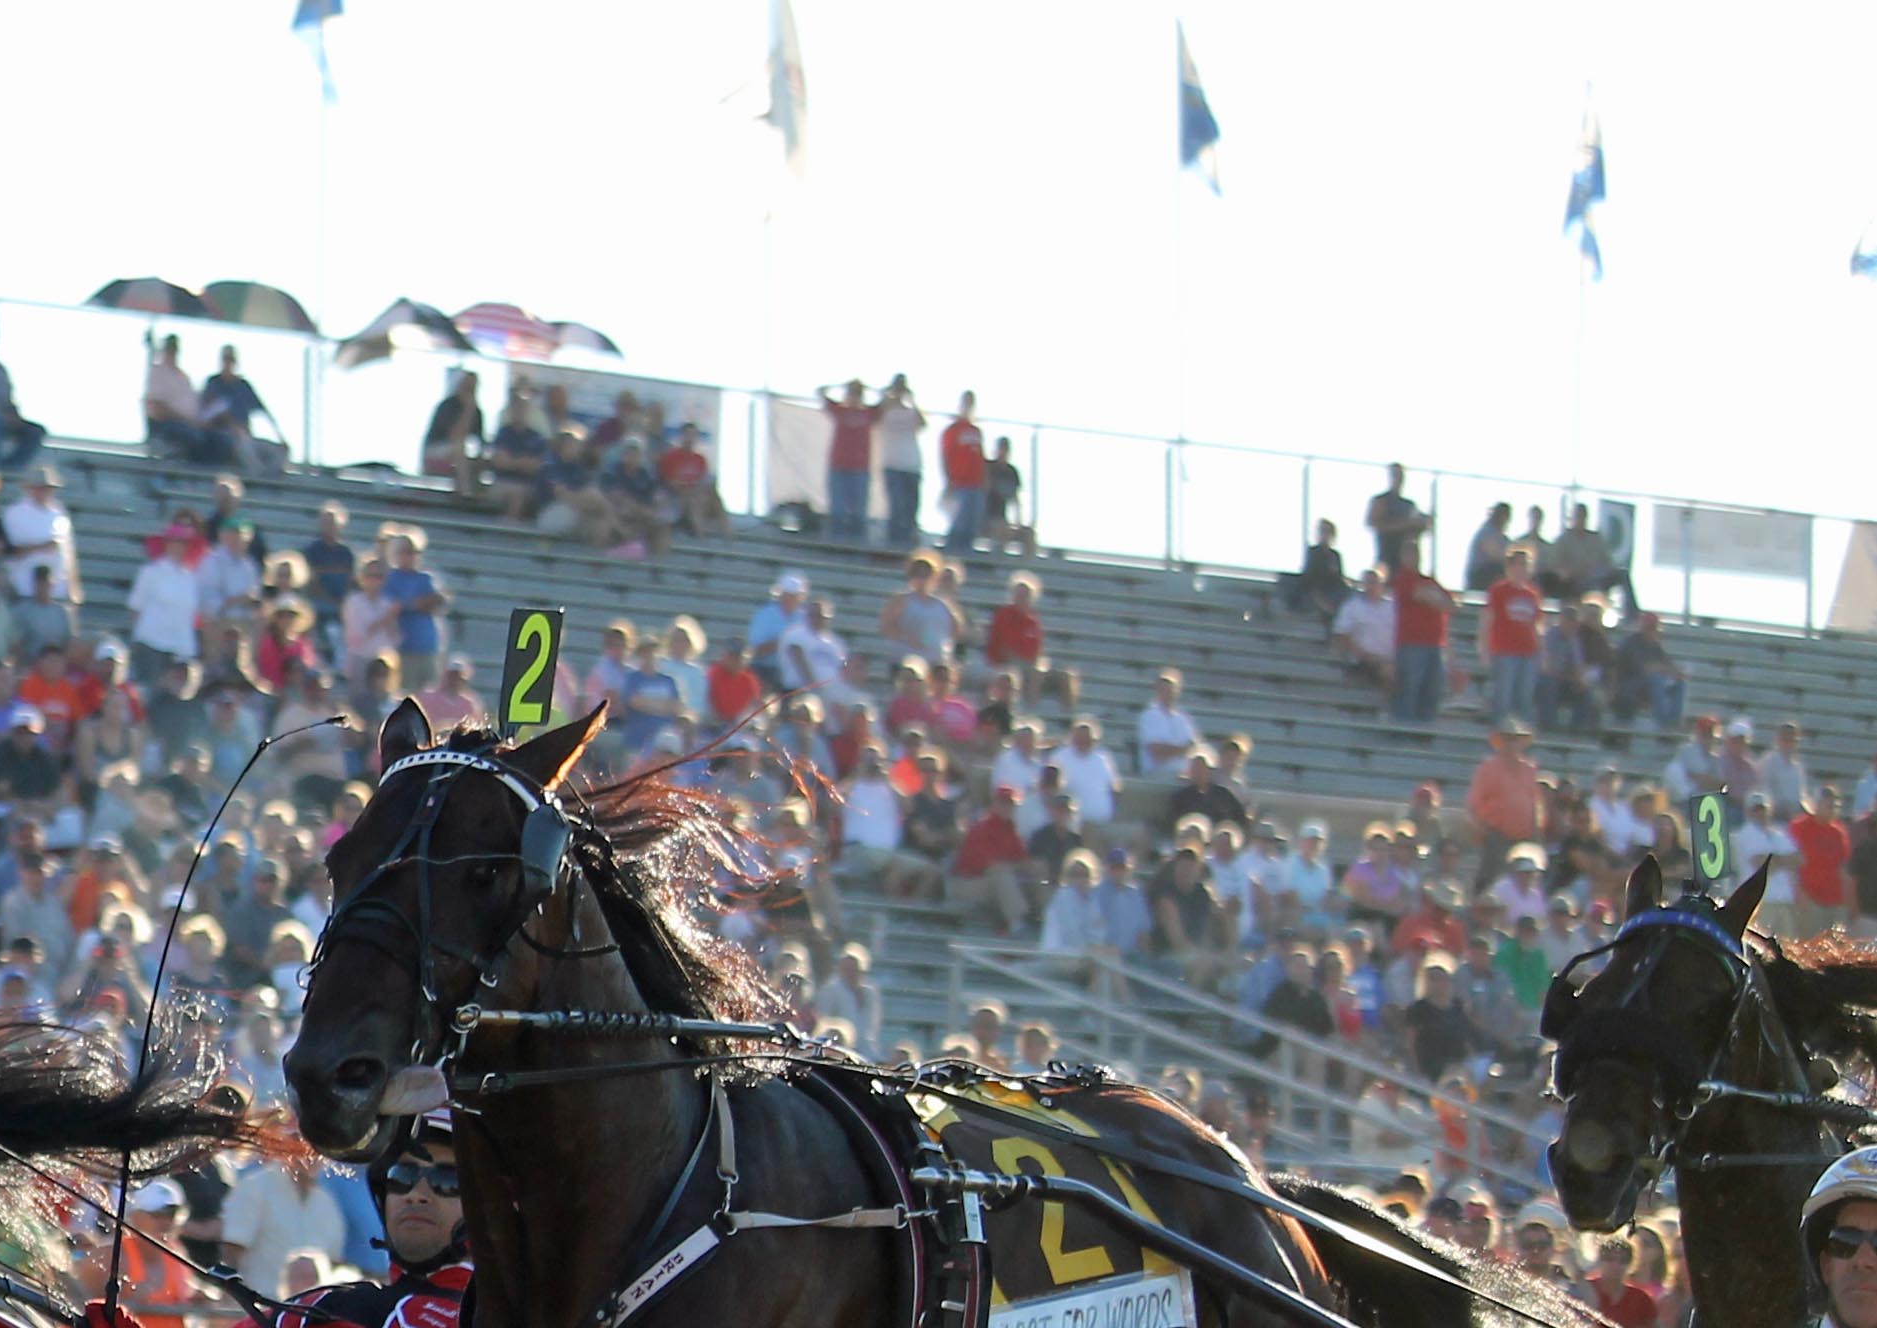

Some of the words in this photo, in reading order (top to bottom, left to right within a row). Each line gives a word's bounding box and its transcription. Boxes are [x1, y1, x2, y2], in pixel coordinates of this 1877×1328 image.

[507, 612, 552, 723] 2
[1698, 794, 1725, 879] 3
[991, 1136, 1115, 1286] 2
